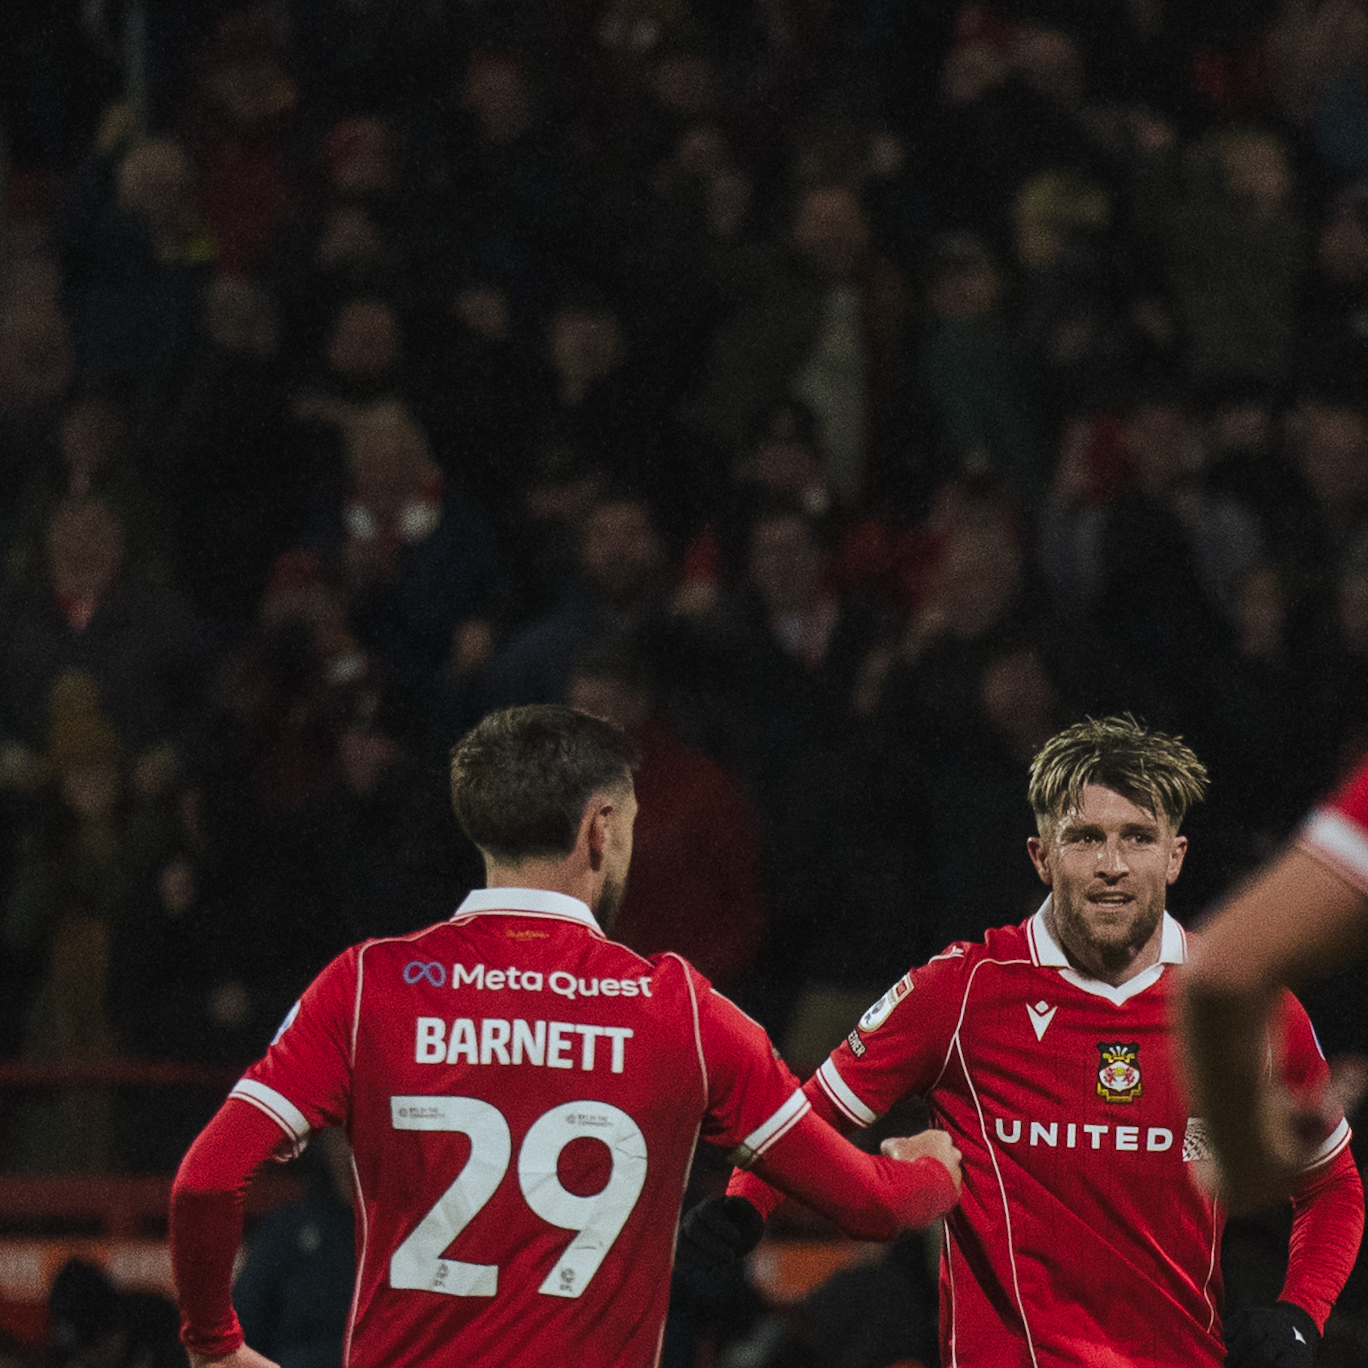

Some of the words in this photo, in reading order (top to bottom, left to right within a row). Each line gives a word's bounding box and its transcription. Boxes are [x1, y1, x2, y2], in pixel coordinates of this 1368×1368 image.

[452, 963, 543, 992] Meta
[548, 970, 653, 1000] Quest
[415, 1016, 634, 1074] BARNETT
[995, 1118, 1174, 1152] UNITED
[389, 1095, 648, 1299] 29
